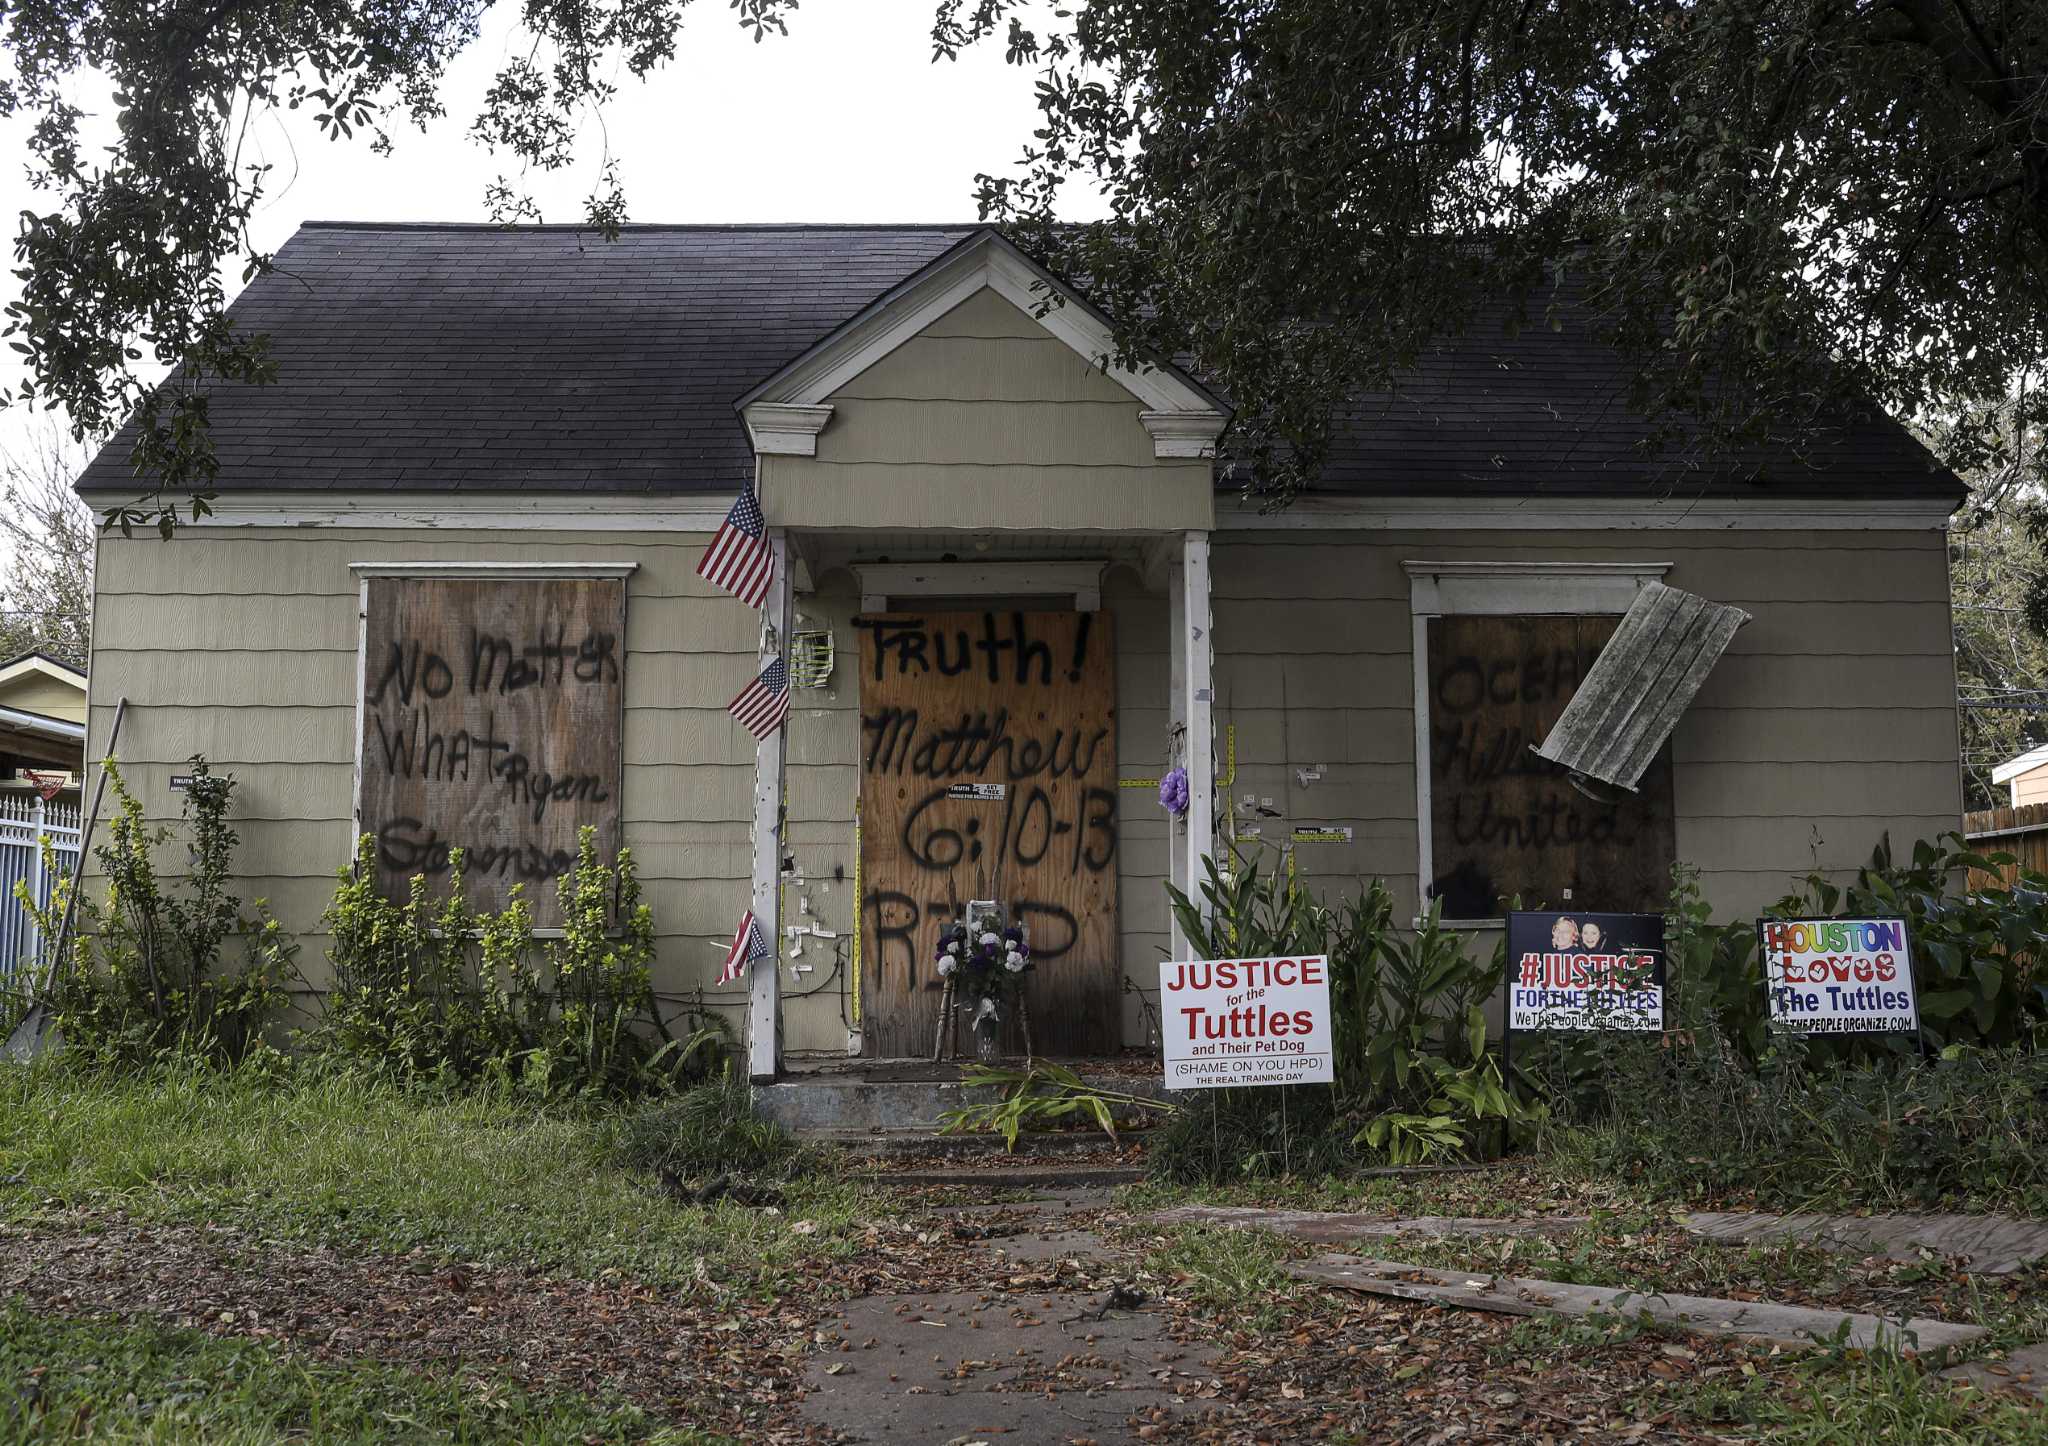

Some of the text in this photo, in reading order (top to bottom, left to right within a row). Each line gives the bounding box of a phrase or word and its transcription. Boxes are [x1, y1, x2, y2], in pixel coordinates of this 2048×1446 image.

[1437, 645, 1600, 714] OCEA
[863, 887, 1078, 992] RP
[1767, 922, 1902, 953] HOUSTON
[1167, 958, 1322, 991] JUSTICE
[1226, 988, 1265, 1007] for the
[1776, 985, 1909, 1012] The Tuttles
[1181, 1004, 1313, 1040] Tuttles
[1192, 1039, 1305, 1056] and Their Pet Dog
[1175, 1056, 1323, 1077] (SHAME ON YOU HPD)
[1196, 1072, 1304, 1085] THE REAL TRAINING DAY
